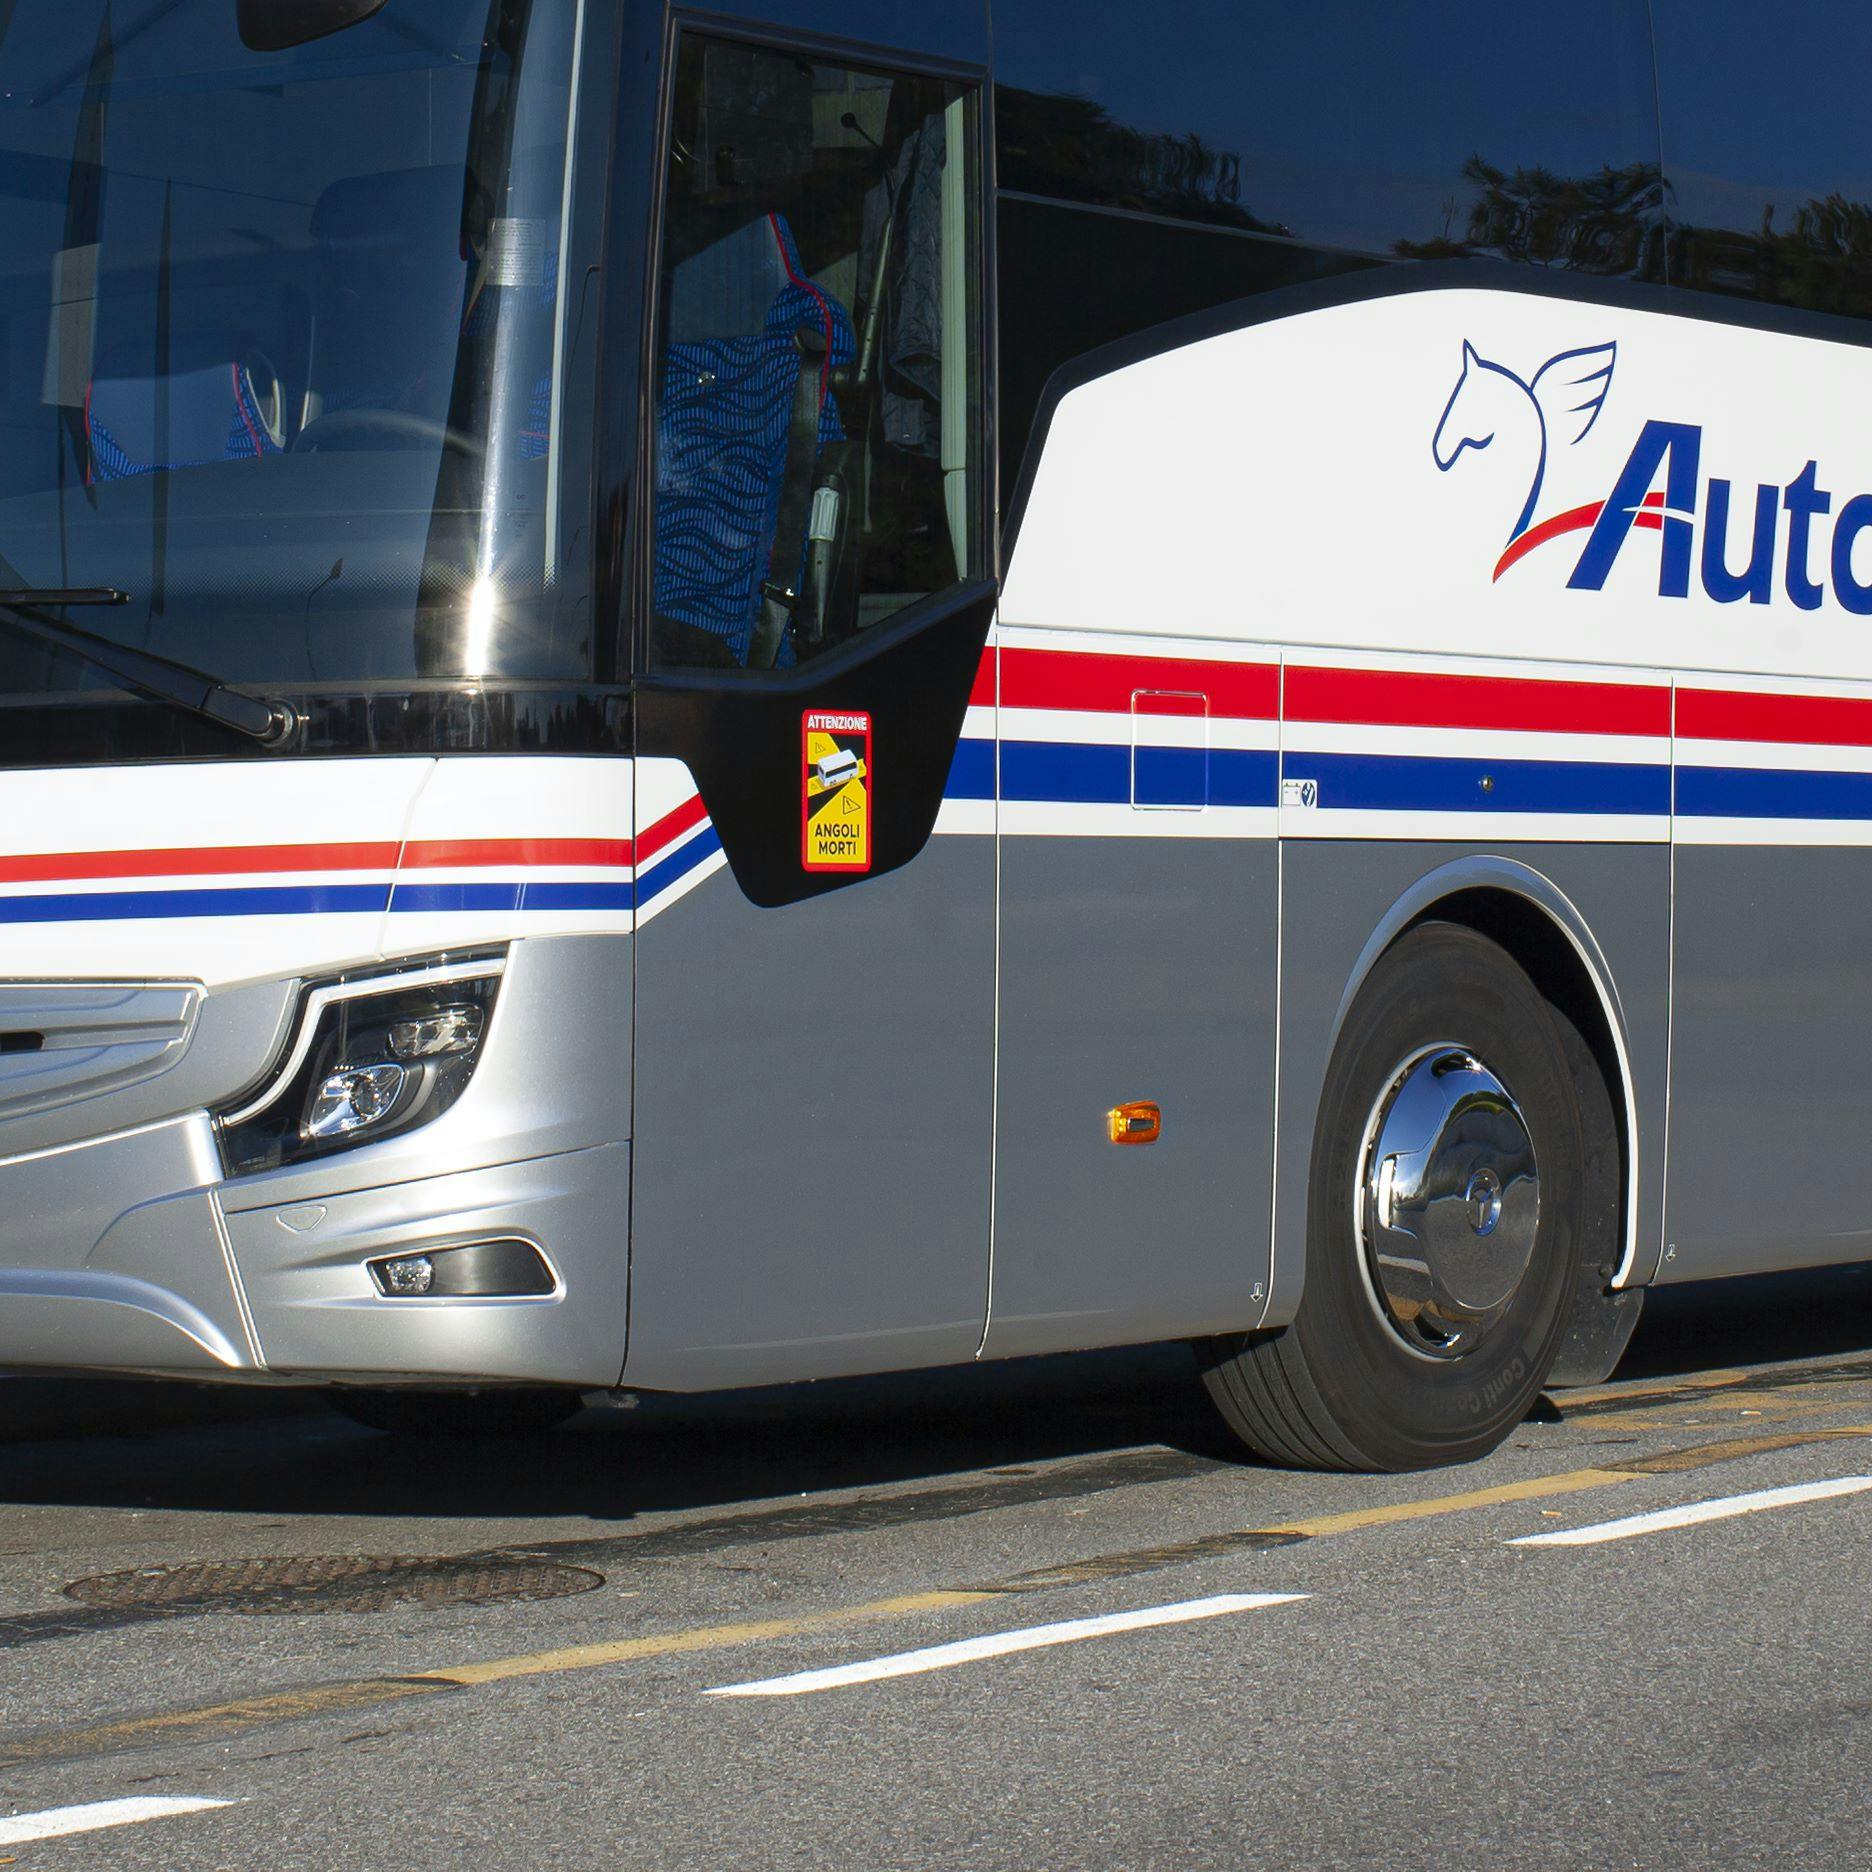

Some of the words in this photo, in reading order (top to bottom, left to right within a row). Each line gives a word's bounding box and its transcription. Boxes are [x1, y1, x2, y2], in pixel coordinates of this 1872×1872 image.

[807, 715, 868, 731] ATTENZIONE
[815, 824, 860, 838] ANGOLI
[818, 841, 857, 855] MORTI
